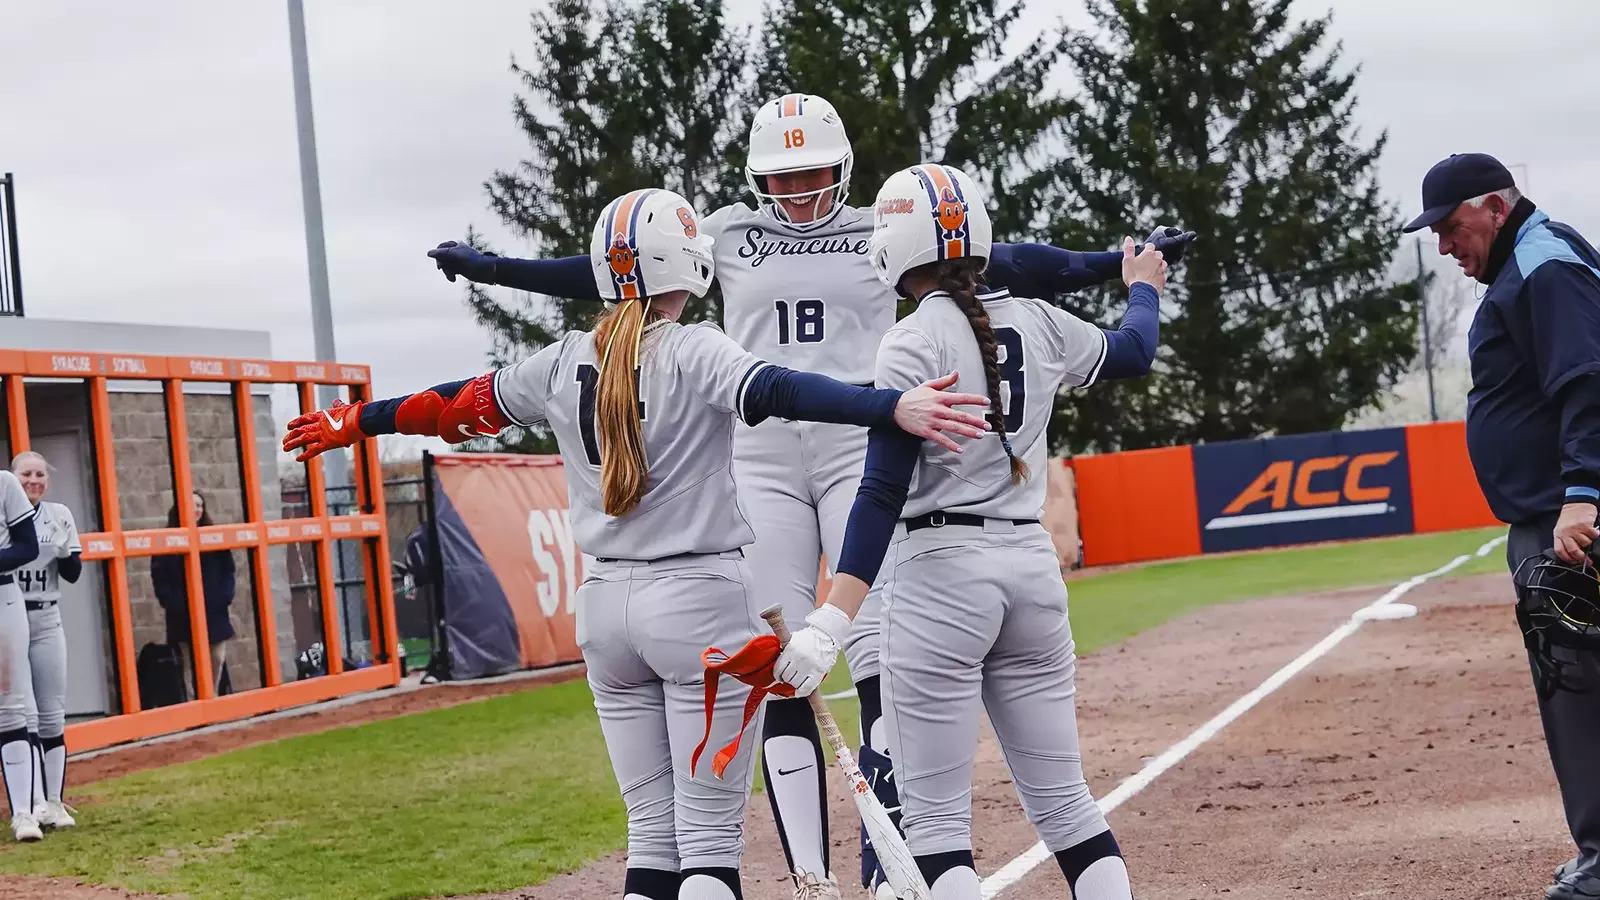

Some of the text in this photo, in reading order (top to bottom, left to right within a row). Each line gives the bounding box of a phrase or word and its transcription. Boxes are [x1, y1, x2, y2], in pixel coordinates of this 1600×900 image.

[784, 128, 805, 149] 18
[738, 226, 869, 267] Syracuse
[774, 299, 826, 345] 18
[52, 355, 147, 373] SYRACUSE SOFTBALL
[1221, 451, 1399, 514] ACC
[18, 569, 47, 592] 44
